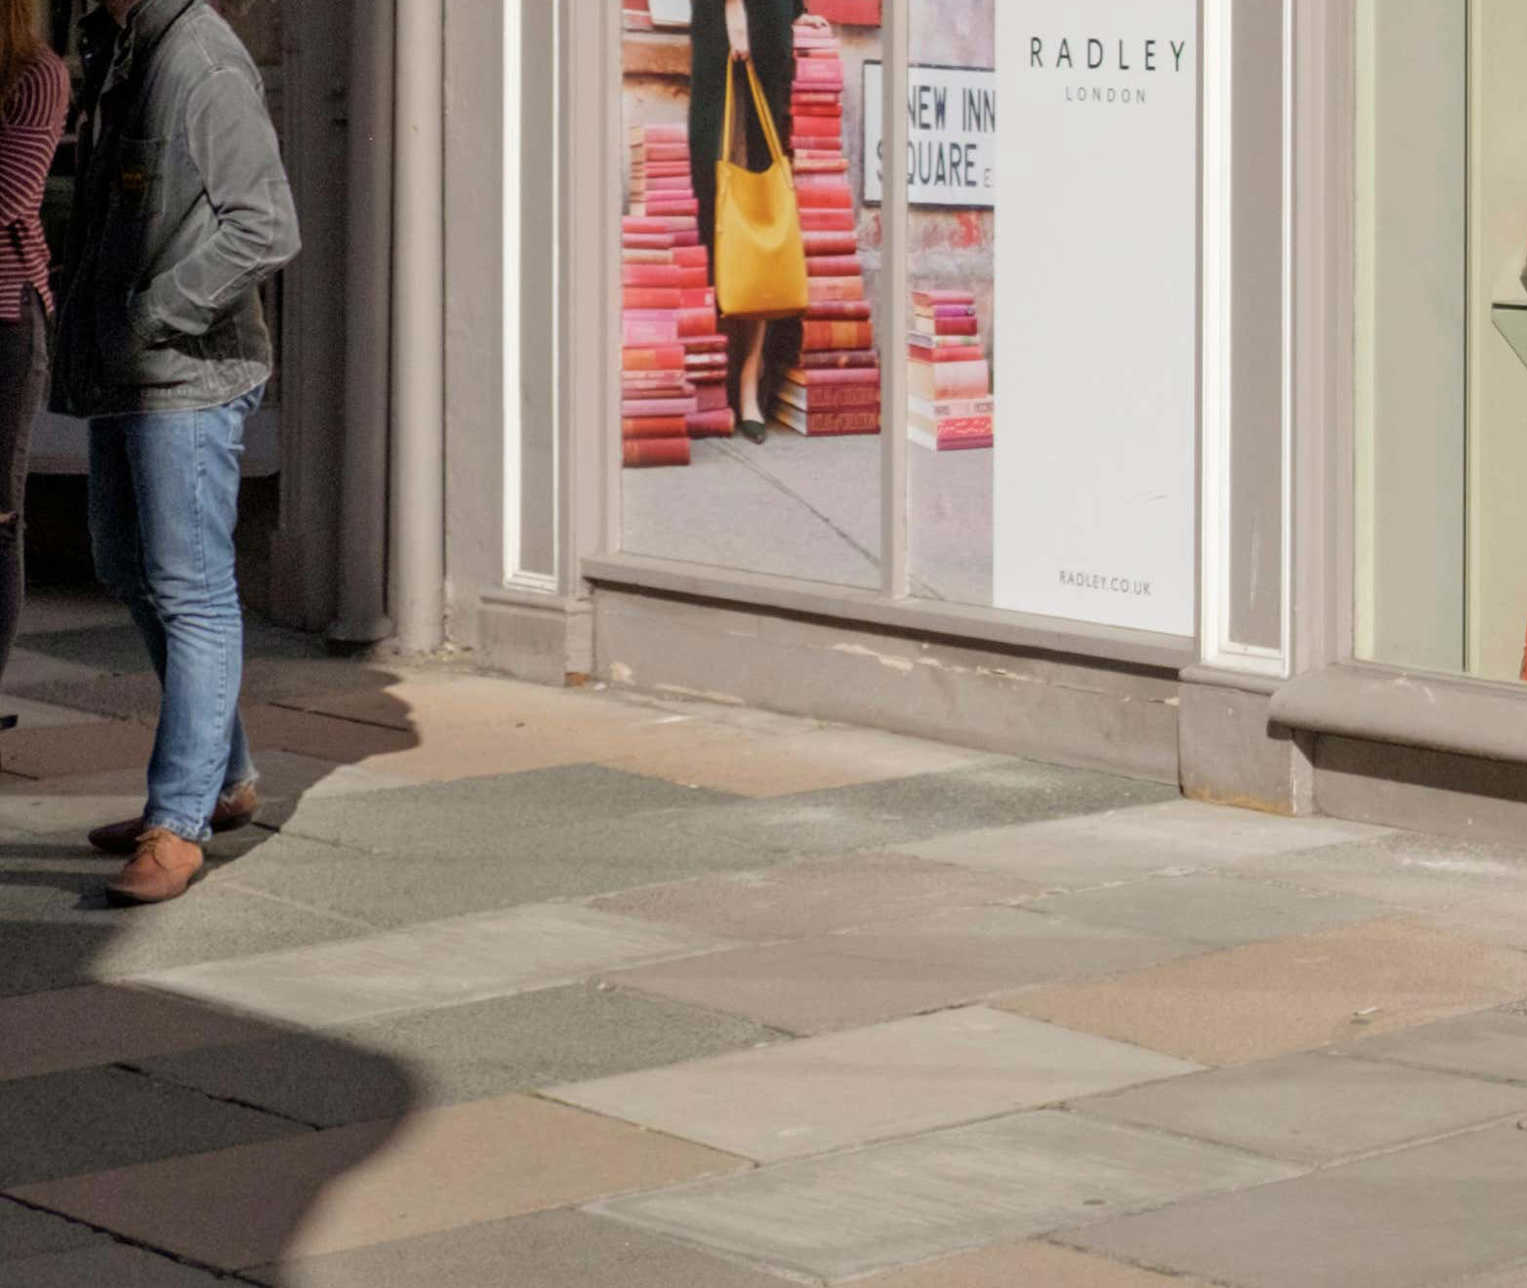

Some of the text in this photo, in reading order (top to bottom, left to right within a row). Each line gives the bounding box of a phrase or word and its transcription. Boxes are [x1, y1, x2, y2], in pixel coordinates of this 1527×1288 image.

[1030, 37, 1185, 72] RADLEY
[962, 88, 996, 132] INN
[1065, 85, 1146, 104] LONDON
